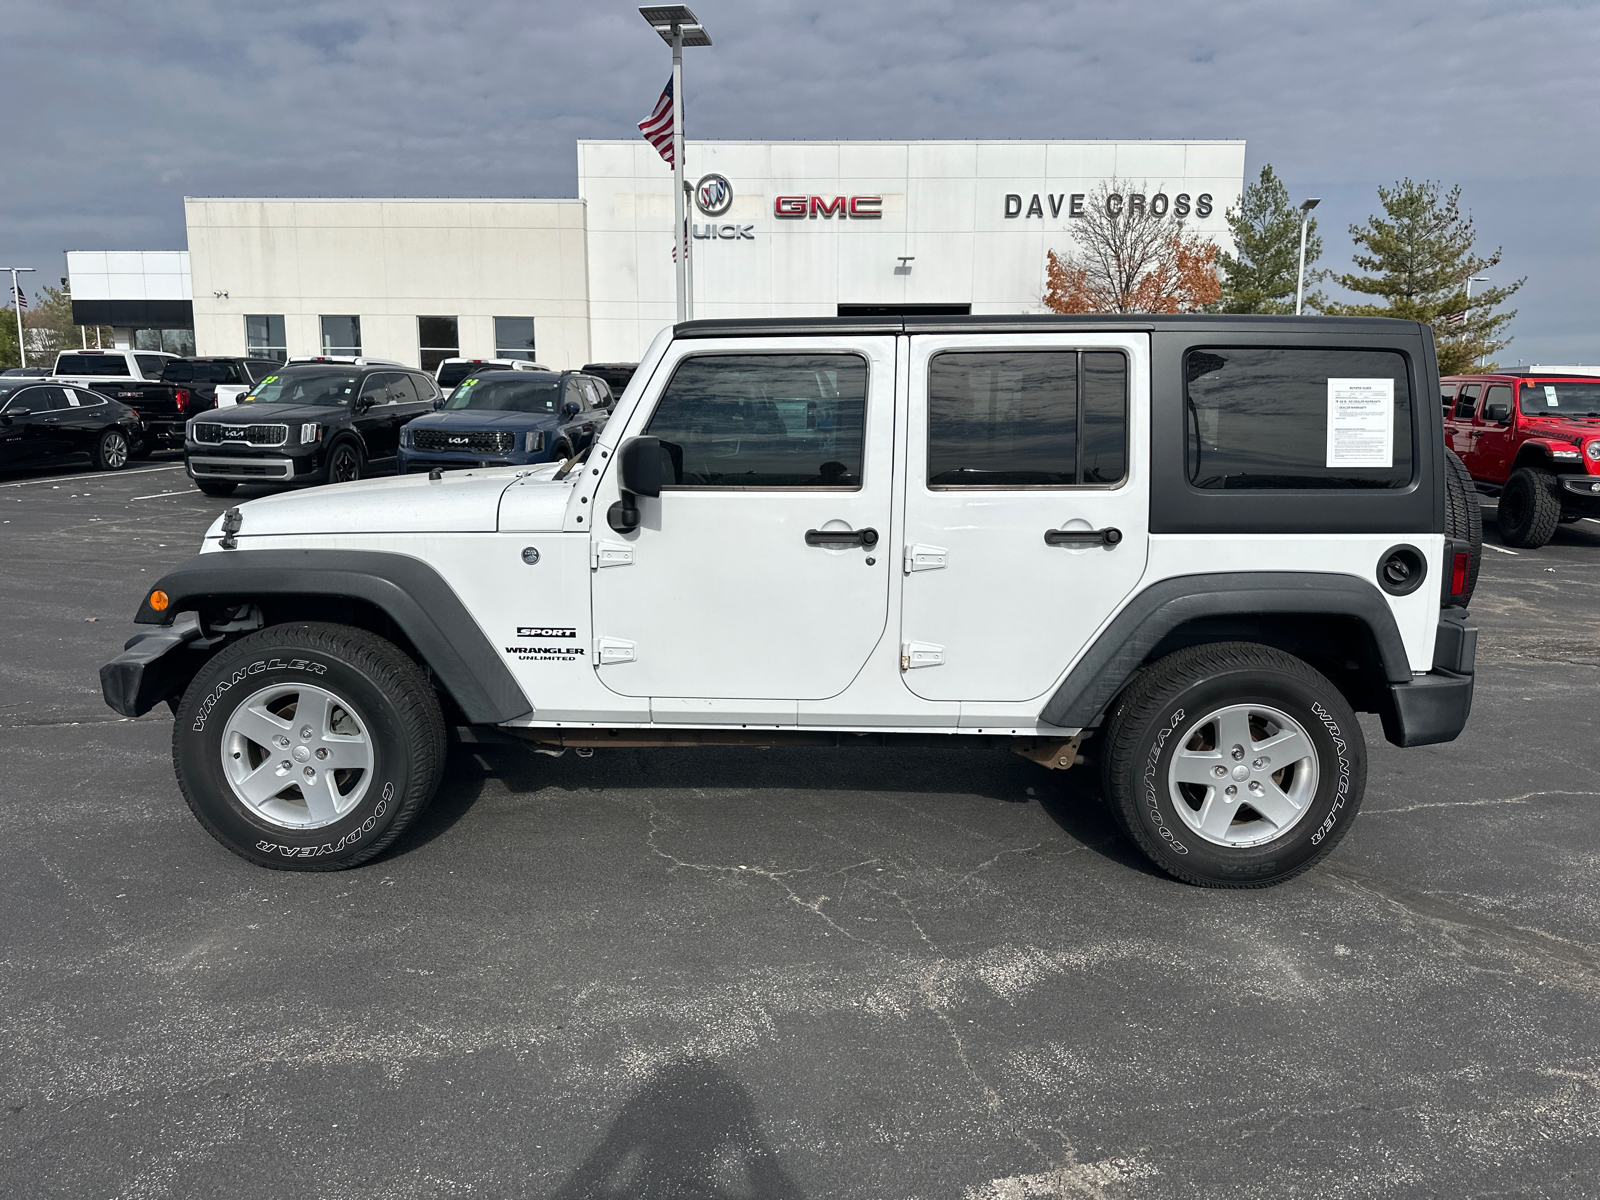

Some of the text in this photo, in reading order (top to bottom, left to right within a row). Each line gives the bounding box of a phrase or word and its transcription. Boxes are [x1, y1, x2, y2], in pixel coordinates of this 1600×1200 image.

[774, 194, 882, 219] GMC
[1004, 193, 1213, 218] DAVE CROSS
[676, 224, 755, 240] UICK
[1529, 428, 1573, 440] RUBICON
[505, 647, 585, 655] WRANGLER
[193, 658, 328, 732] WRANGLER
[1144, 708, 1188, 855] GOODYEAR
[1311, 702, 1350, 845] WRANGLER
[256, 782, 395, 858] GOODYEAR
